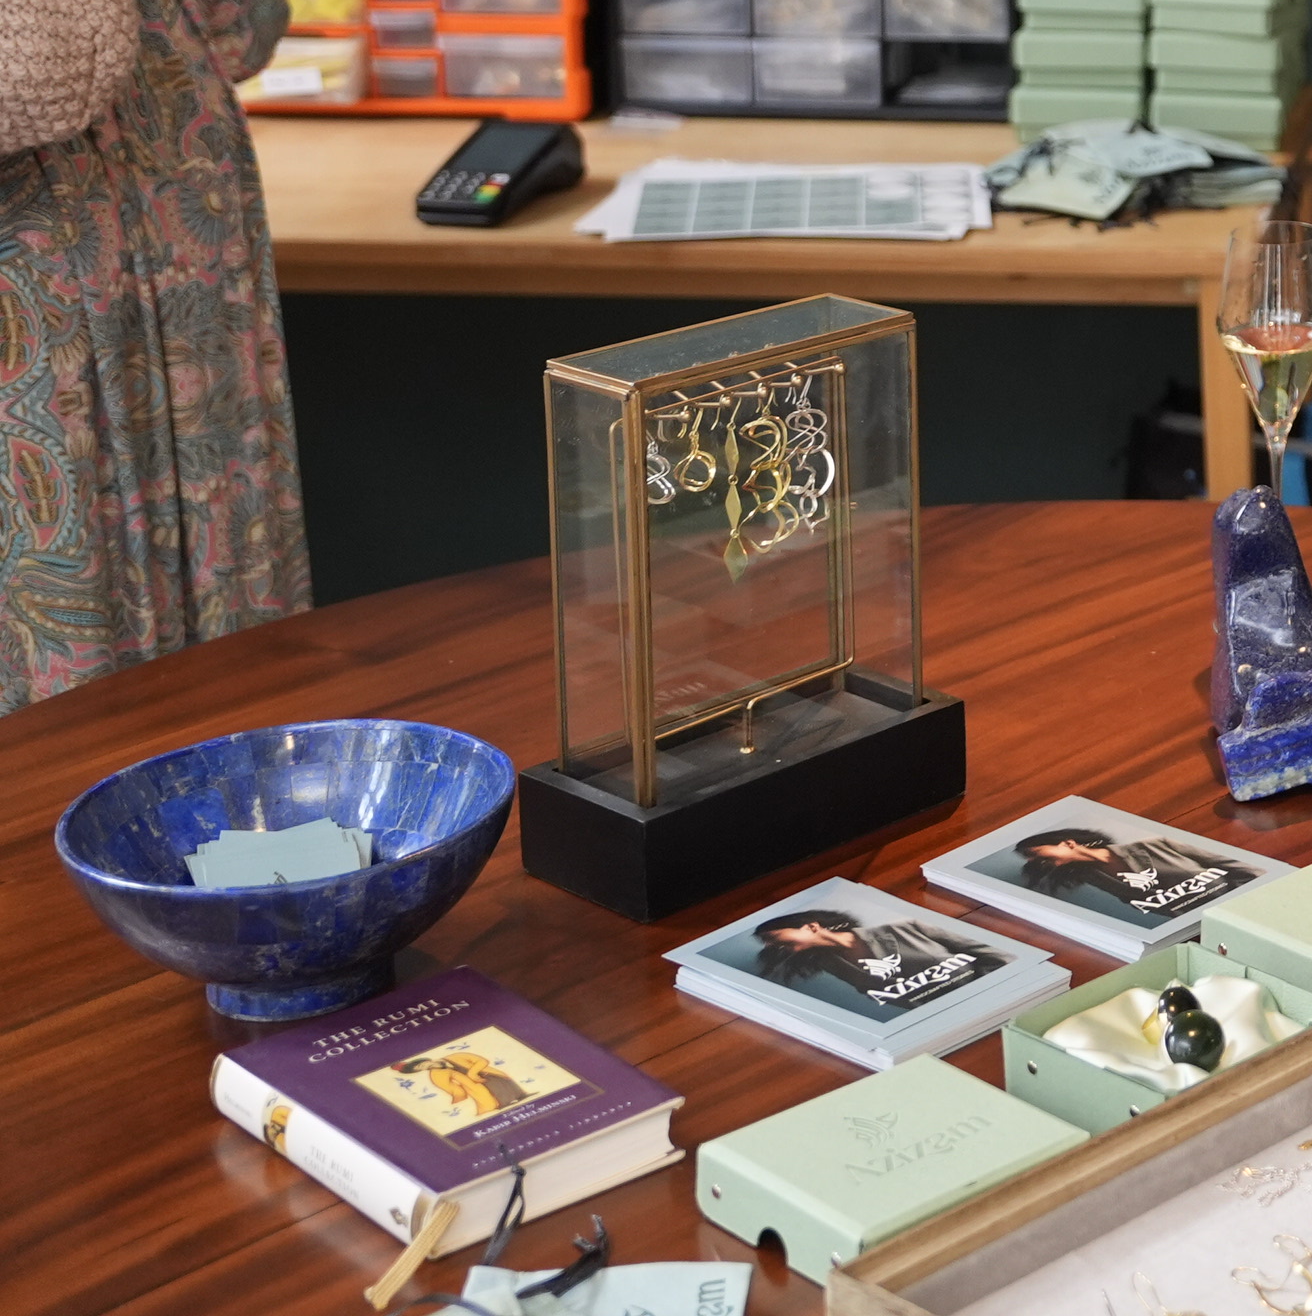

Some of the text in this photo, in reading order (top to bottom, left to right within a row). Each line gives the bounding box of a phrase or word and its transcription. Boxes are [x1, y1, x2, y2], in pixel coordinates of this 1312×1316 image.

[308, 1000, 470, 1064] COLLECTION
[312, 999, 440, 1048] THE RUMI
